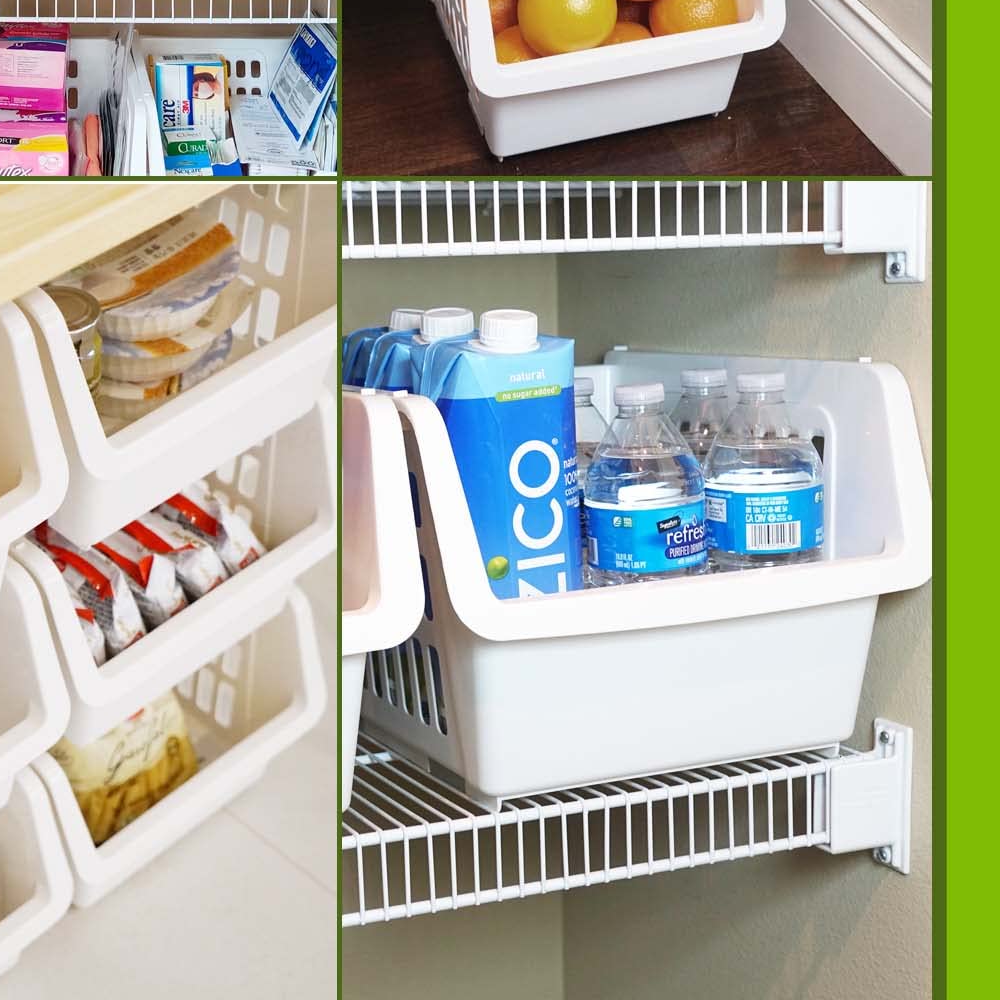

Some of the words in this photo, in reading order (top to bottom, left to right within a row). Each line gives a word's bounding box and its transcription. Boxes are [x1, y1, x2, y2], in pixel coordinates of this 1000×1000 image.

[182, 100, 190, 114] 3M
[509, 367, 546, 384] natural
[502, 392, 512, 401] no
[512, 390, 533, 401] sugar
[666, 524, 705, 546] refres
